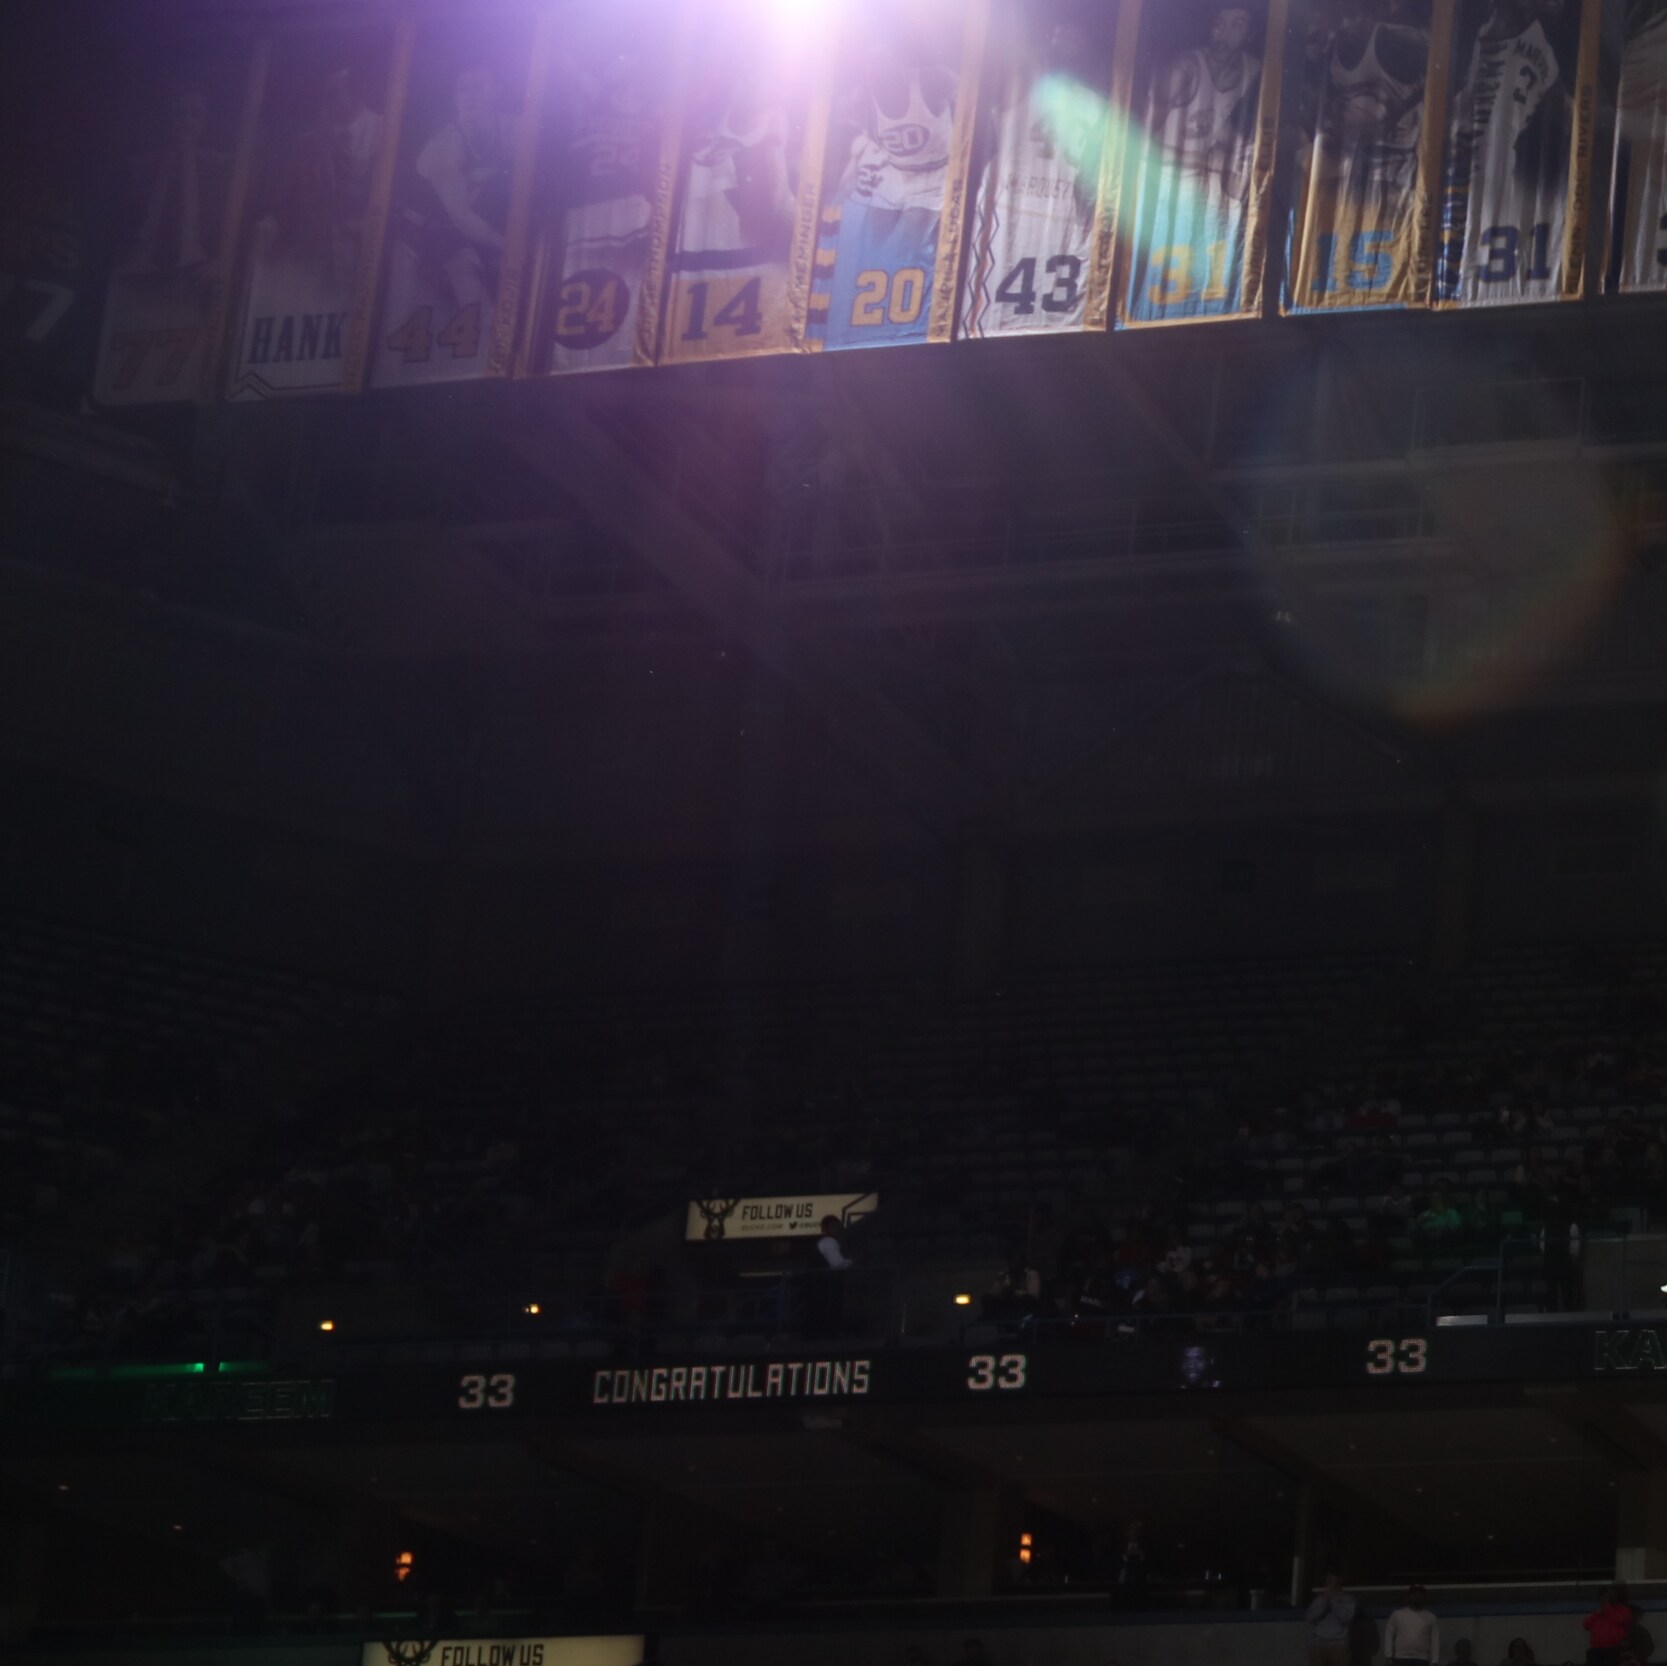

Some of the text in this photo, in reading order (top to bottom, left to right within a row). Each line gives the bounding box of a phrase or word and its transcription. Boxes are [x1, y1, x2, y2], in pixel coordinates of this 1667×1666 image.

[1147, 241, 1228, 306] 31
[1309, 229, 1394, 295] 15
[1477, 223, 1550, 283] 31
[557, 279, 619, 337] 24
[681, 275, 763, 342] 14
[850, 266, 927, 327] 20
[995, 253, 1084, 316] 43
[248, 312, 349, 364] HANK
[387, 302, 481, 364] 44
[741, 1202, 813, 1221] FOLLOW US
[592, 1360, 871, 1406] CONGRATULATIONS
[967, 1354, 1028, 1391] 33
[1366, 1339, 1427, 1375] 33
[457, 1373, 518, 1409] 33
[519, 1643, 545, 1666] US
